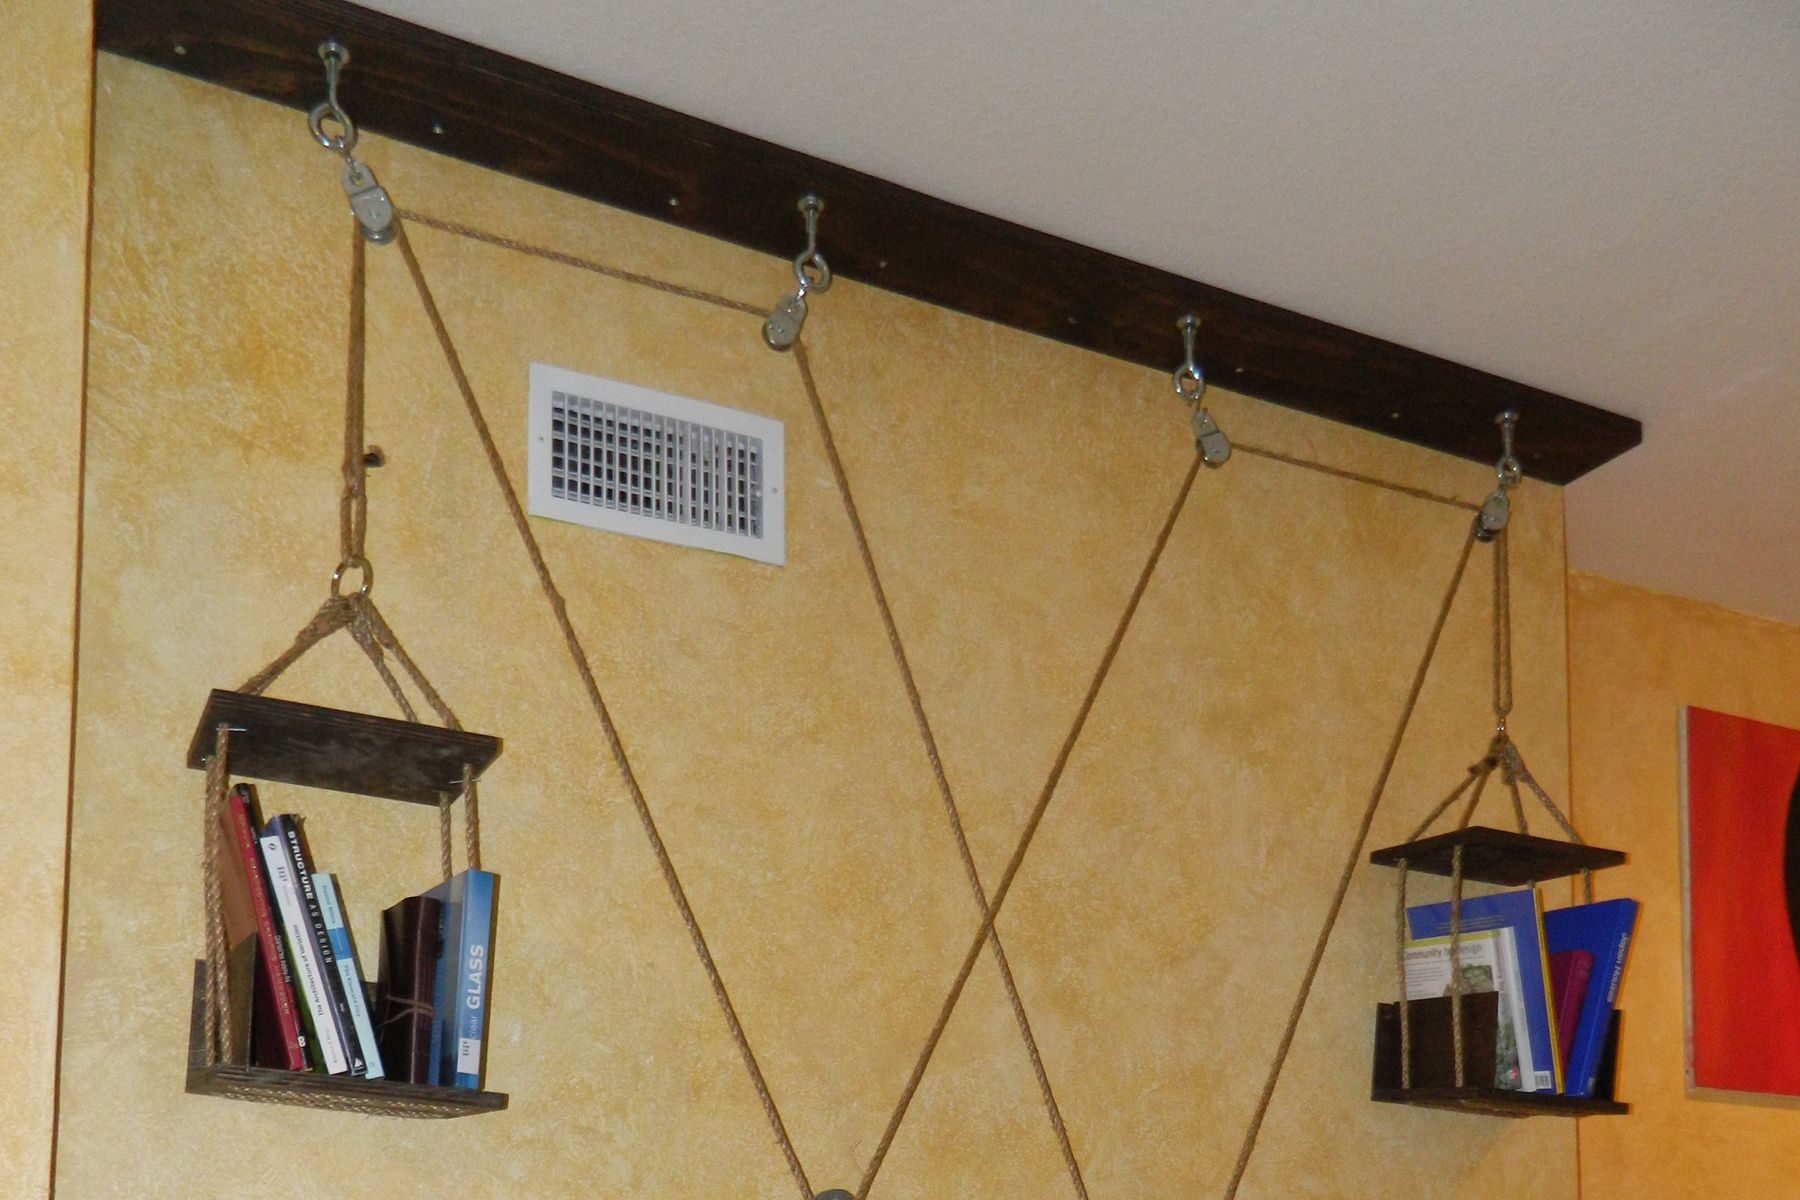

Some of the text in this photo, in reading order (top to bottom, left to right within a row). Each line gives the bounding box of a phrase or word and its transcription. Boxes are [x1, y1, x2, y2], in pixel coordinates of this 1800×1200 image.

[288, 830, 333, 964] STRUCTURE AS DESIGN
[301, 955, 308, 963] of
[465, 943, 485, 1010] GLASS
[303, 963, 320, 1004] Architecture
[1604, 965, 1624, 1003] Houses
[316, 1004, 324, 1016] The
